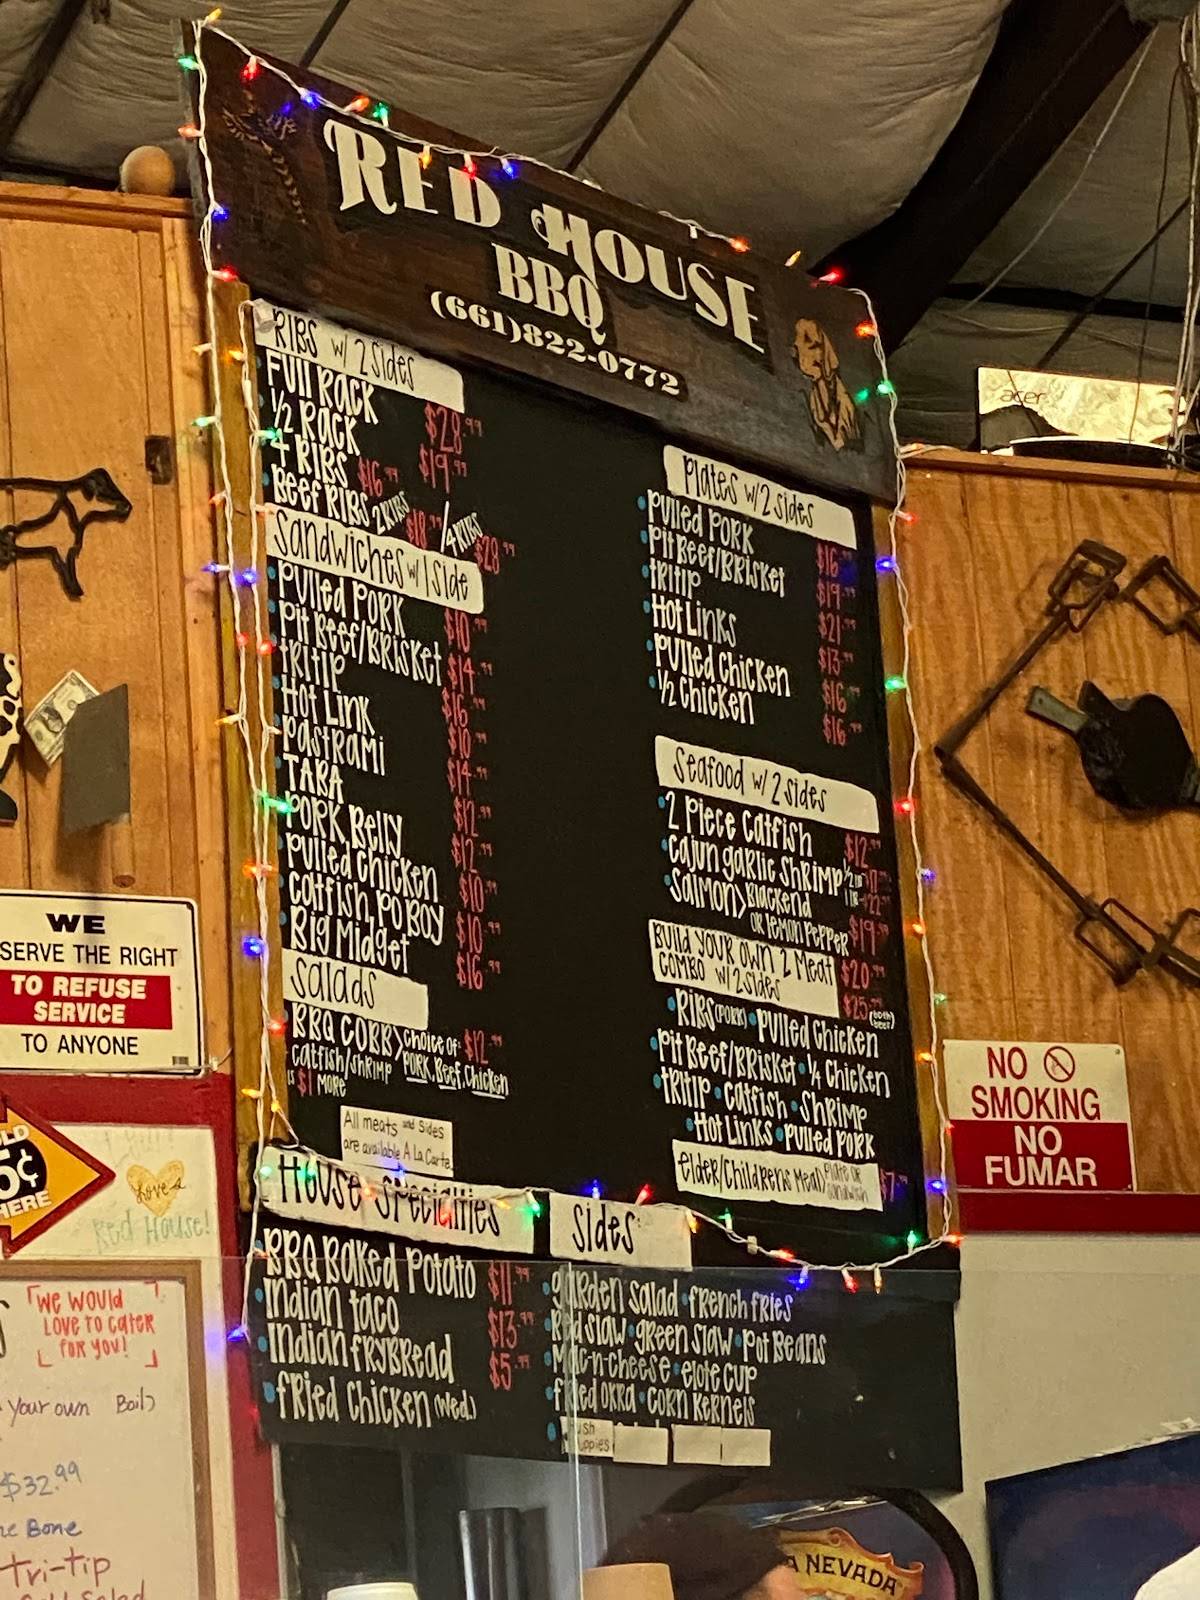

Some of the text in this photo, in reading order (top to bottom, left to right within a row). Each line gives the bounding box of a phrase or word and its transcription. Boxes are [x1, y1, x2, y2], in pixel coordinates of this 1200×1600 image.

[323, 119, 765, 354] RED HOUSE
[491, 243, 606, 344] BBQ
[430, 290, 680, 396] (661)822-0772
[1000, 389, 1046, 406] acer
[273, 508, 404, 589] Sandwiches
[673, 746, 745, 795] Seafood
[665, 791, 680, 830] 2
[46, 913, 105, 935] WE
[0, 941, 178, 967] SERVE THE RIGHT
[11, 974, 147, 1000] TO REFUSE
[290, 957, 377, 1009] Salads
[34, 1001, 126, 1025] SERVICE
[21, 1034, 139, 1056] TO ANYONE
[987, 1047, 1027, 1080] NO
[971, 1085, 1101, 1120] SMOKING
[344, 1110, 359, 1129] All
[363, 1116, 397, 1136] meats
[1014, 1125, 1062, 1155] NO
[985, 1156, 1097, 1187] FUMAR
[263, 1228, 321, 1283] BBQ
[805, 1553, 897, 1596] NEVADA
